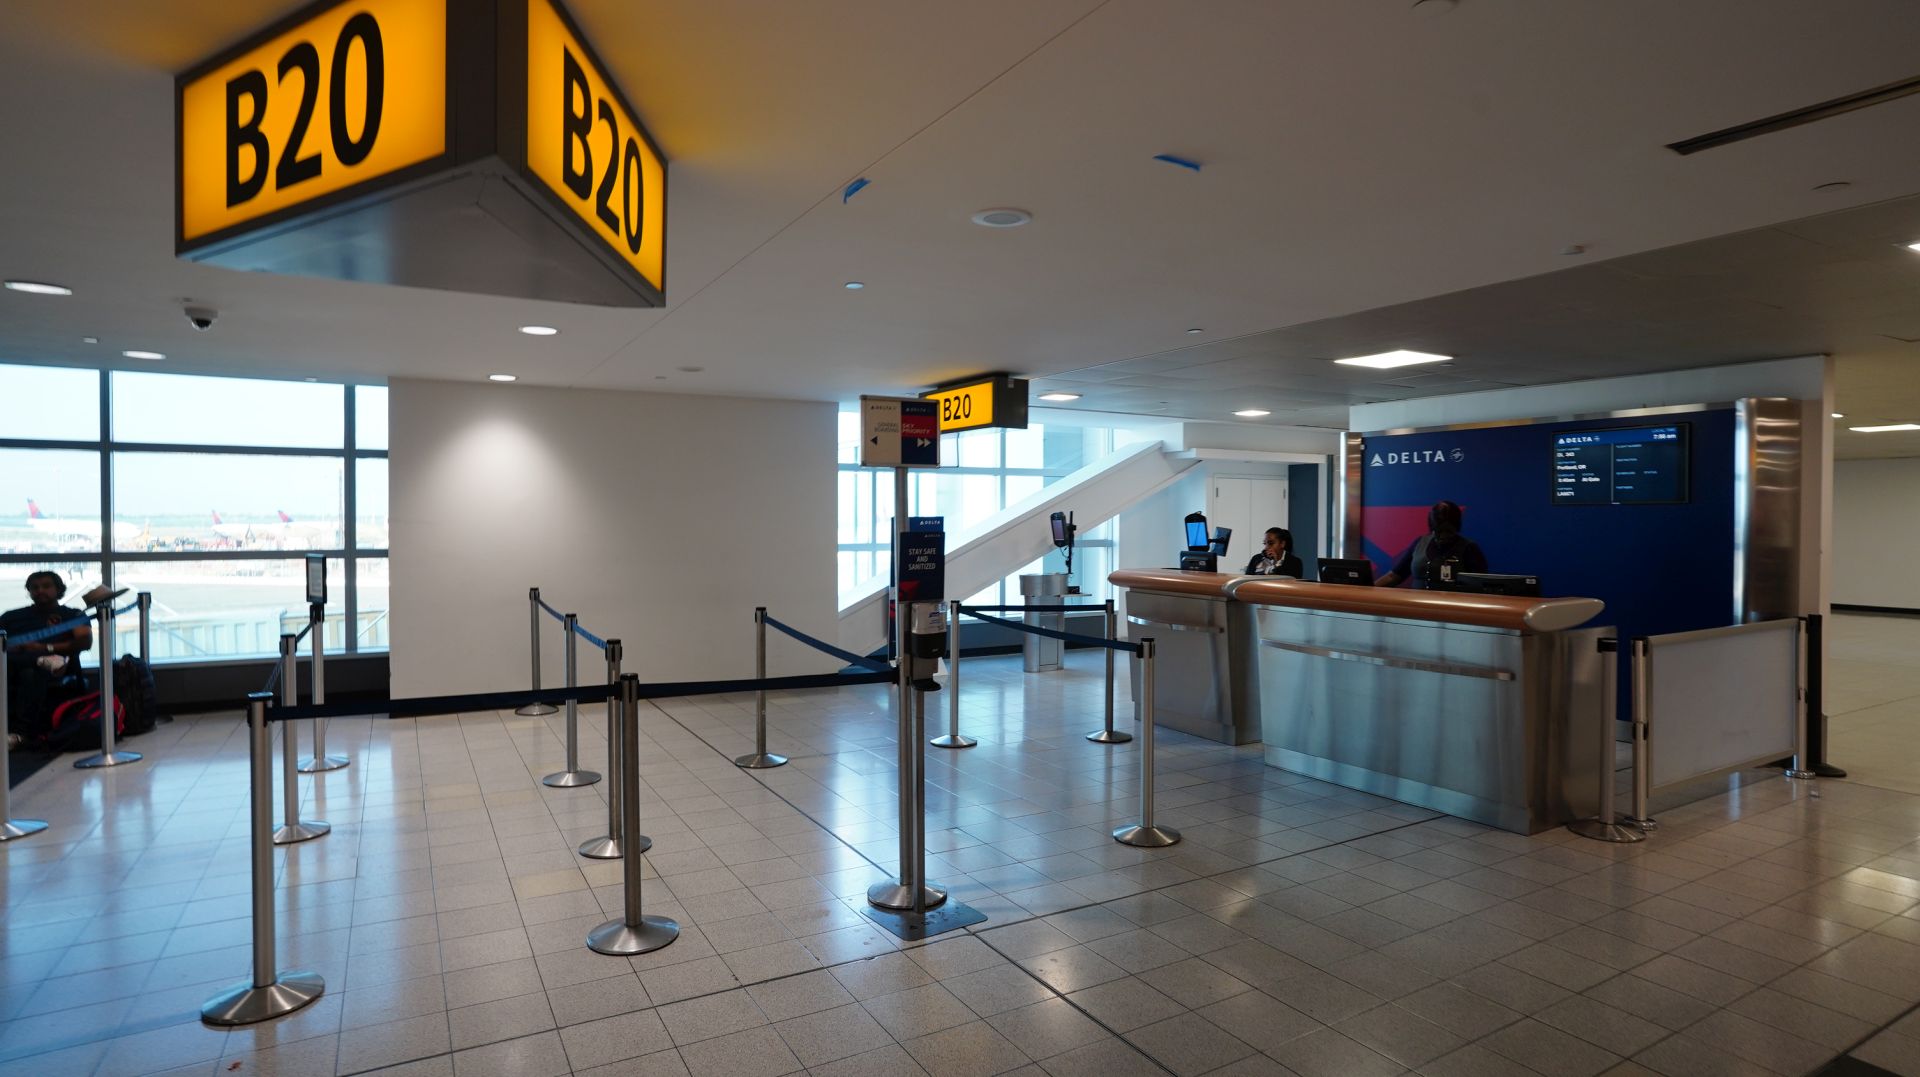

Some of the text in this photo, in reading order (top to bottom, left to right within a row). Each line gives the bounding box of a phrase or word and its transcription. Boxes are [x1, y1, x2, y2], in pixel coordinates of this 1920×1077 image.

[225, 11, 385, 209] B20
[562, 42, 645, 256] B20
[943, 393, 972, 422] B20
[1565, 436, 1593, 444] DELTA
[1387, 450, 1445, 465] DELTA
[908, 548, 922, 556] STAY
[908, 563, 936, 571] SANITIZED
